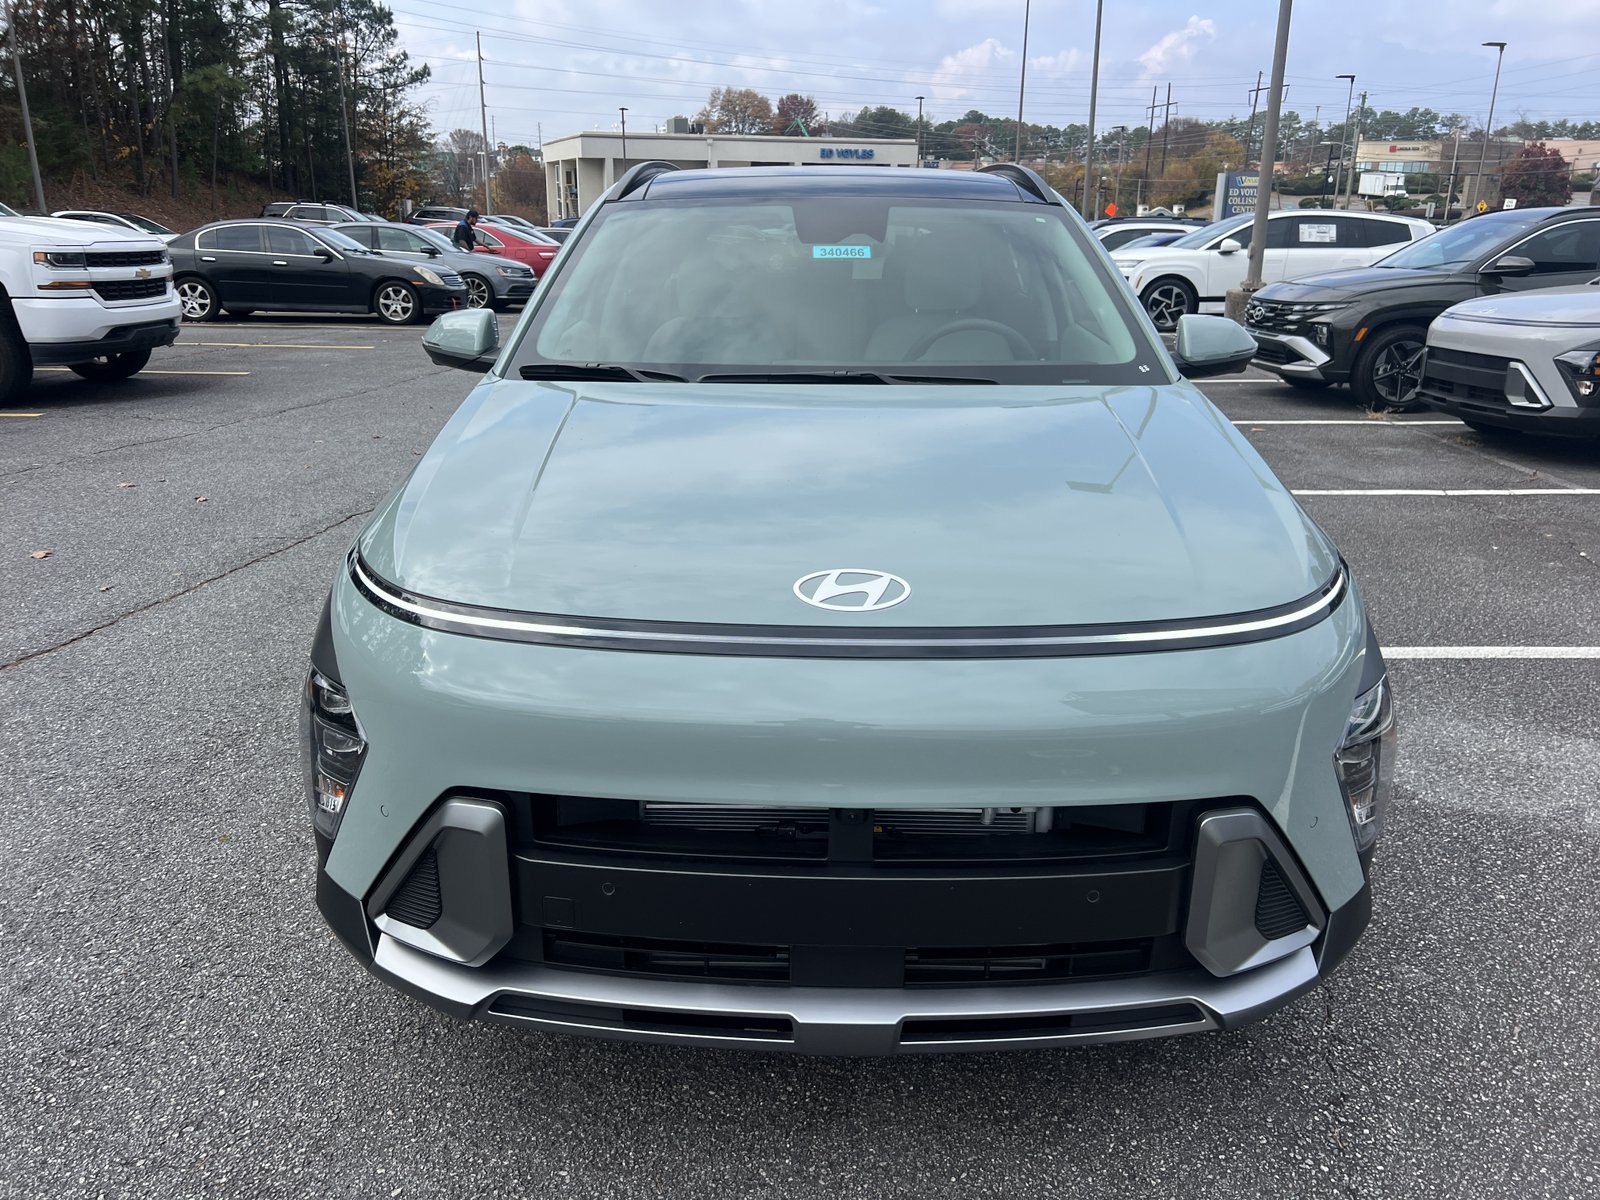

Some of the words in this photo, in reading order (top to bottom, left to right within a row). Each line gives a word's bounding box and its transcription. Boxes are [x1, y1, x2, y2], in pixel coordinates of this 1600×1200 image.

[820, 148, 834, 158] ED
[836, 148, 874, 159] VOYLES
[1229, 188, 1239, 196] ED
[1240, 188, 1257, 196] VOYL
[1232, 205, 1255, 214] CENTE
[820, 248, 865, 257] 340466
